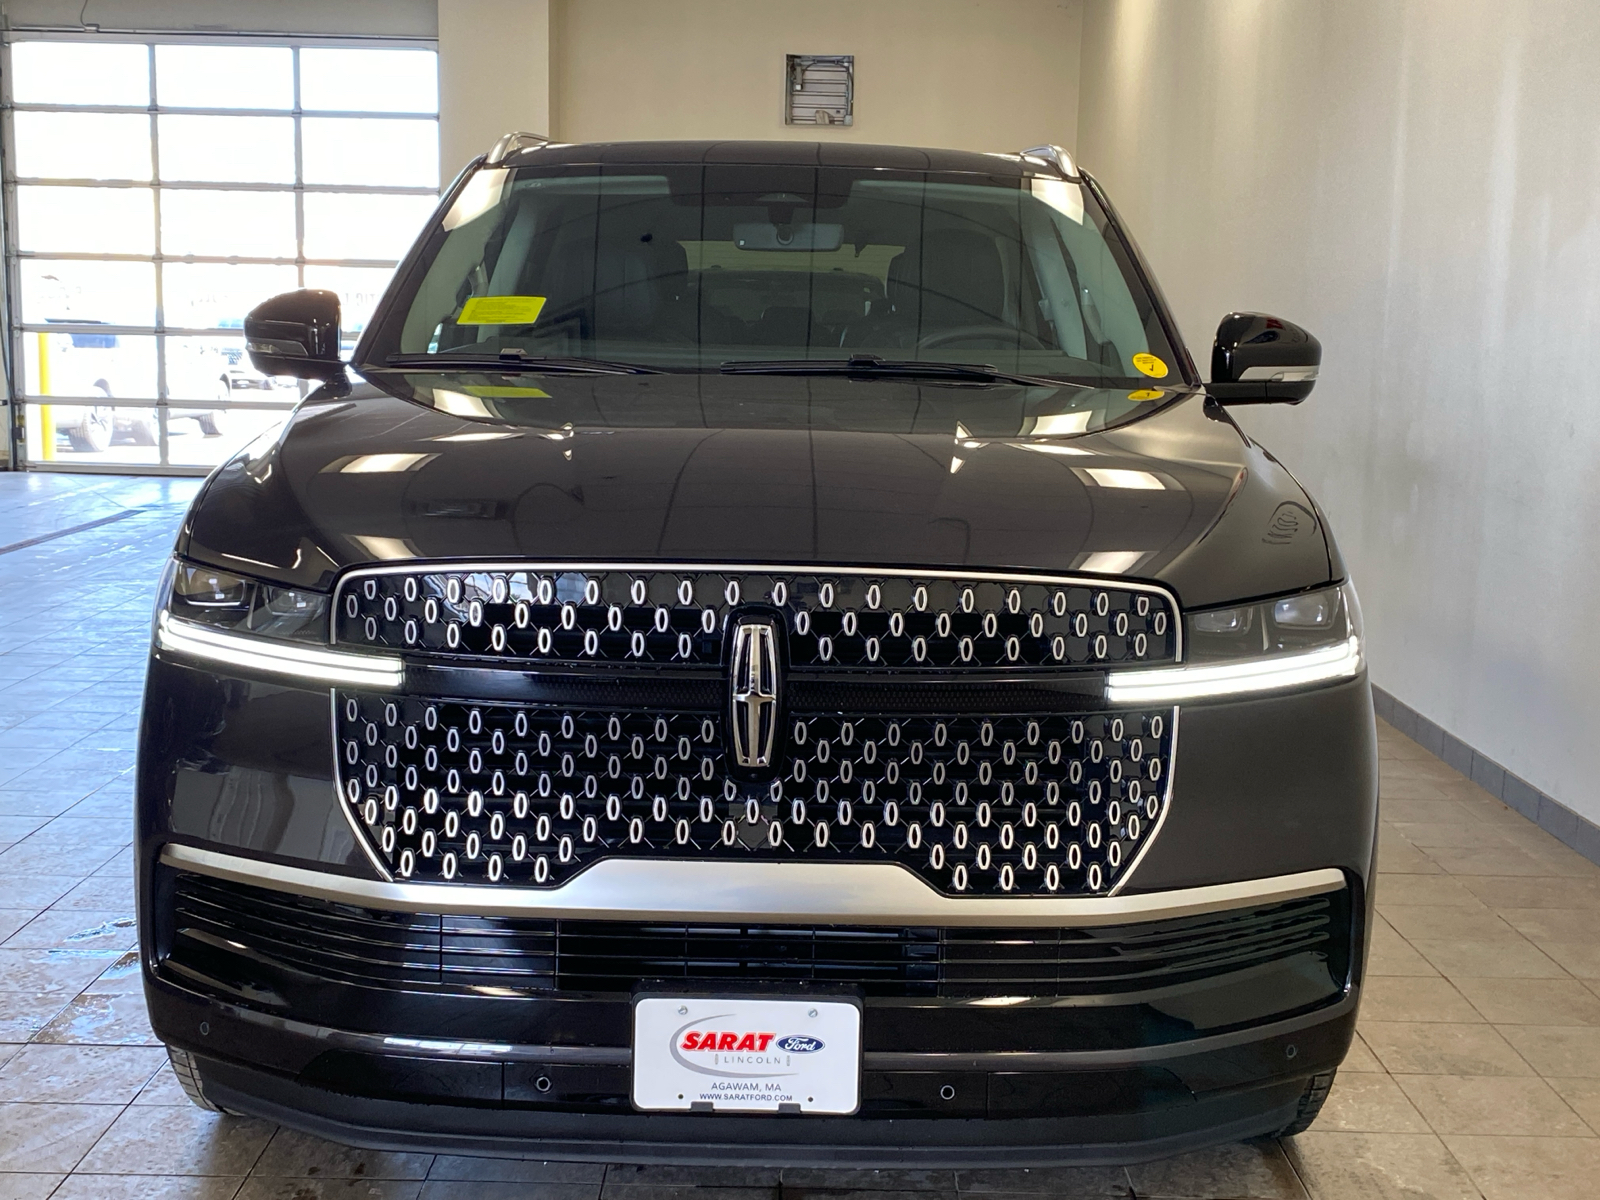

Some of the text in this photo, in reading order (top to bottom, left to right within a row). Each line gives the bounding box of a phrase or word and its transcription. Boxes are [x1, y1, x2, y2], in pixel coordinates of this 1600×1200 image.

[681, 1031, 817, 1052] SARAT Ford
[724, 1056, 781, 1064] LINCOLN
[711, 1082, 782, 1092] AGAWAM, MA
[699, 1093, 793, 1102] WWW.SARATFORD.COM
